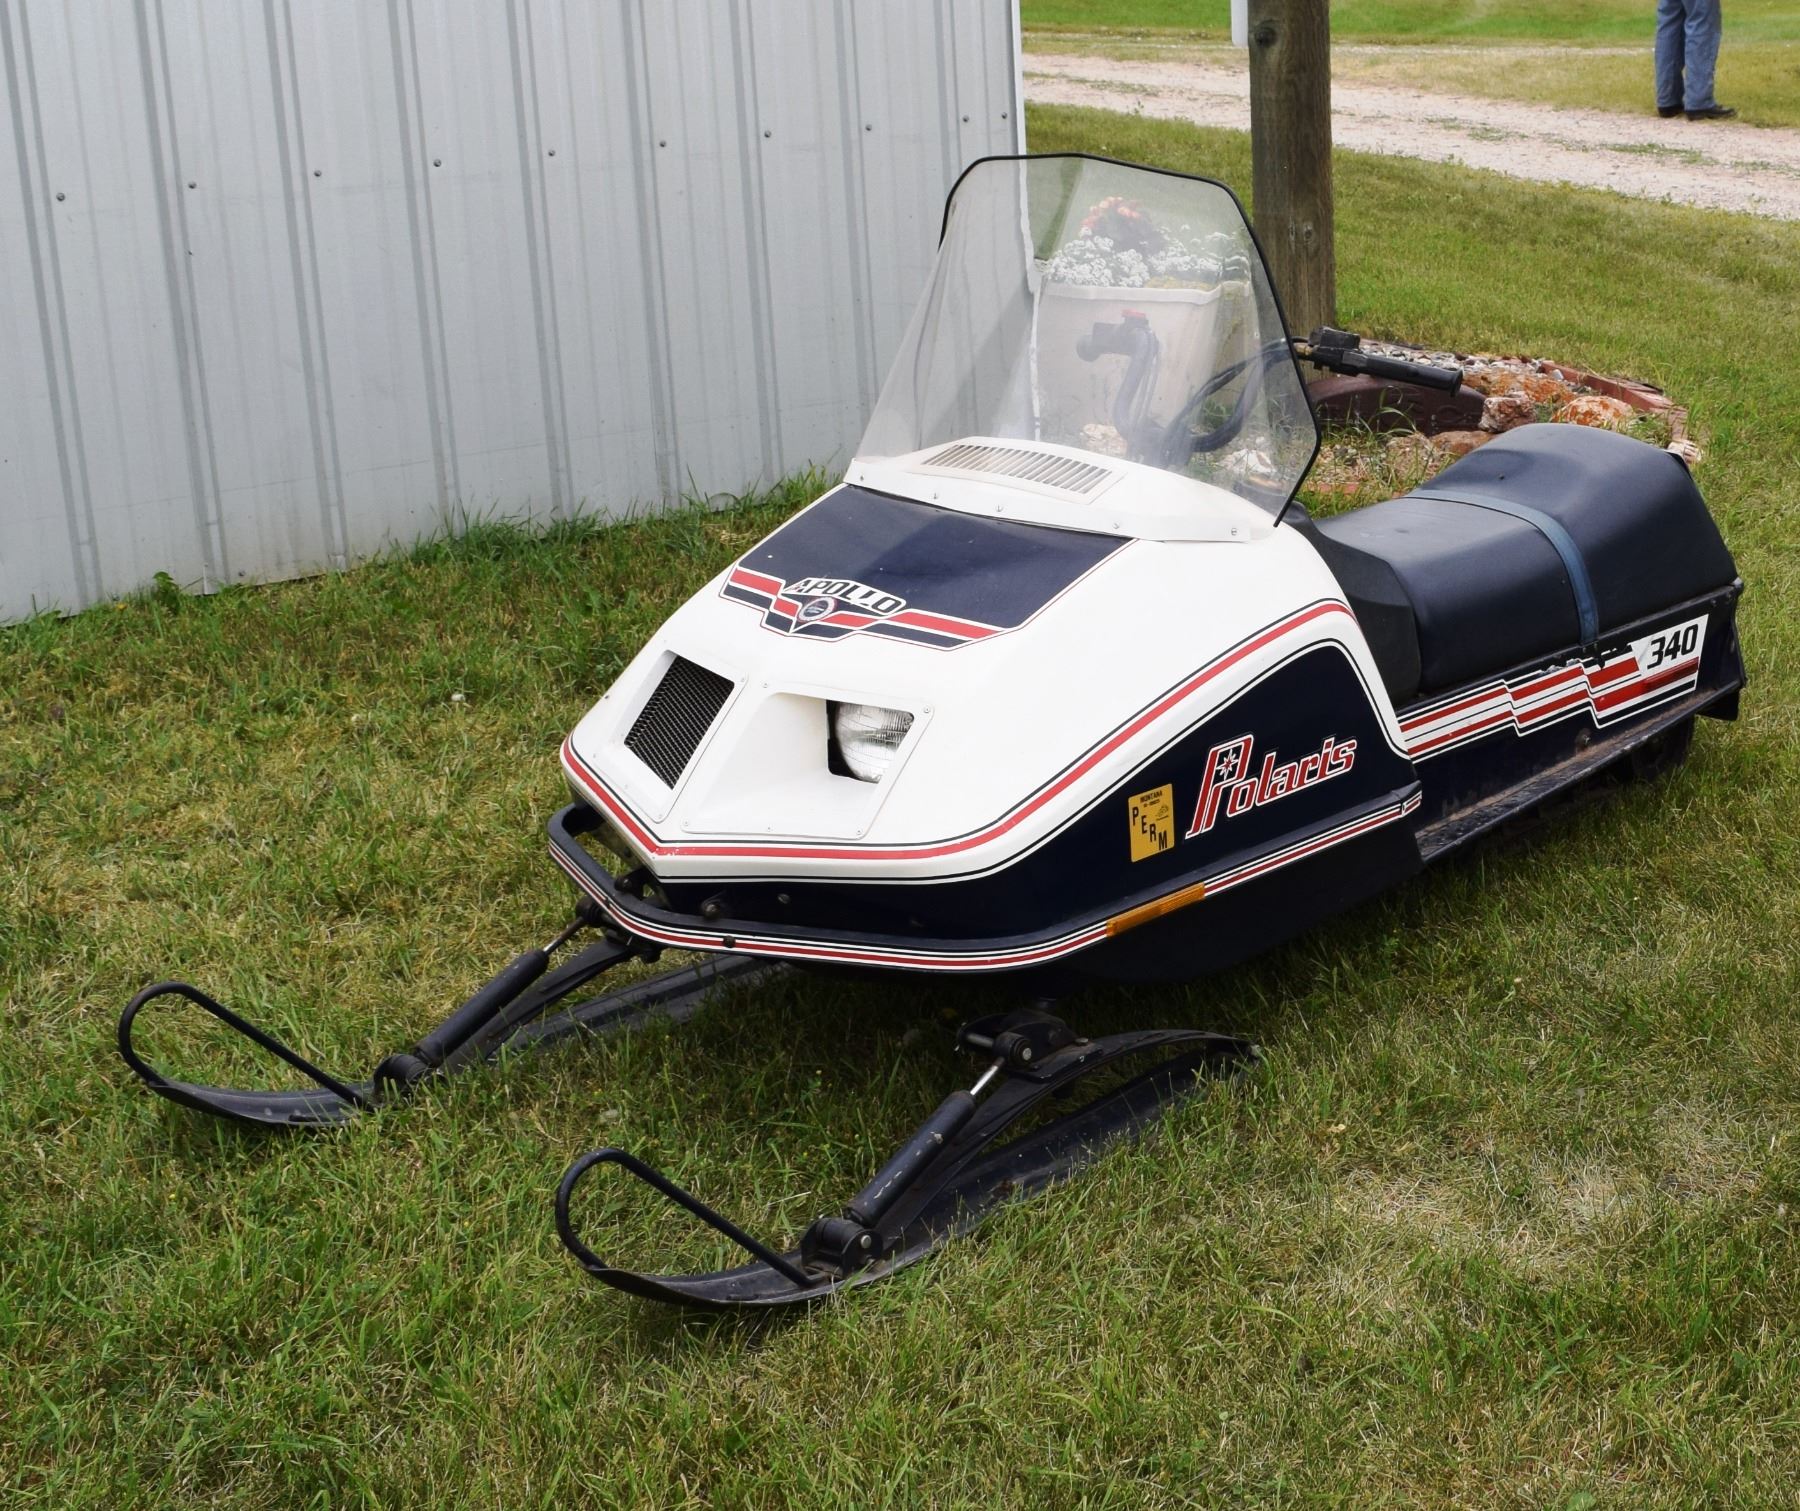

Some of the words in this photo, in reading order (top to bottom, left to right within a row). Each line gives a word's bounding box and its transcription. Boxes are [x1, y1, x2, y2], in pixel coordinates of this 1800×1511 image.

[797, 579, 902, 613] APOLLO
[1648, 624, 1699, 669] 340
[1185, 734, 1357, 839] Polaris
